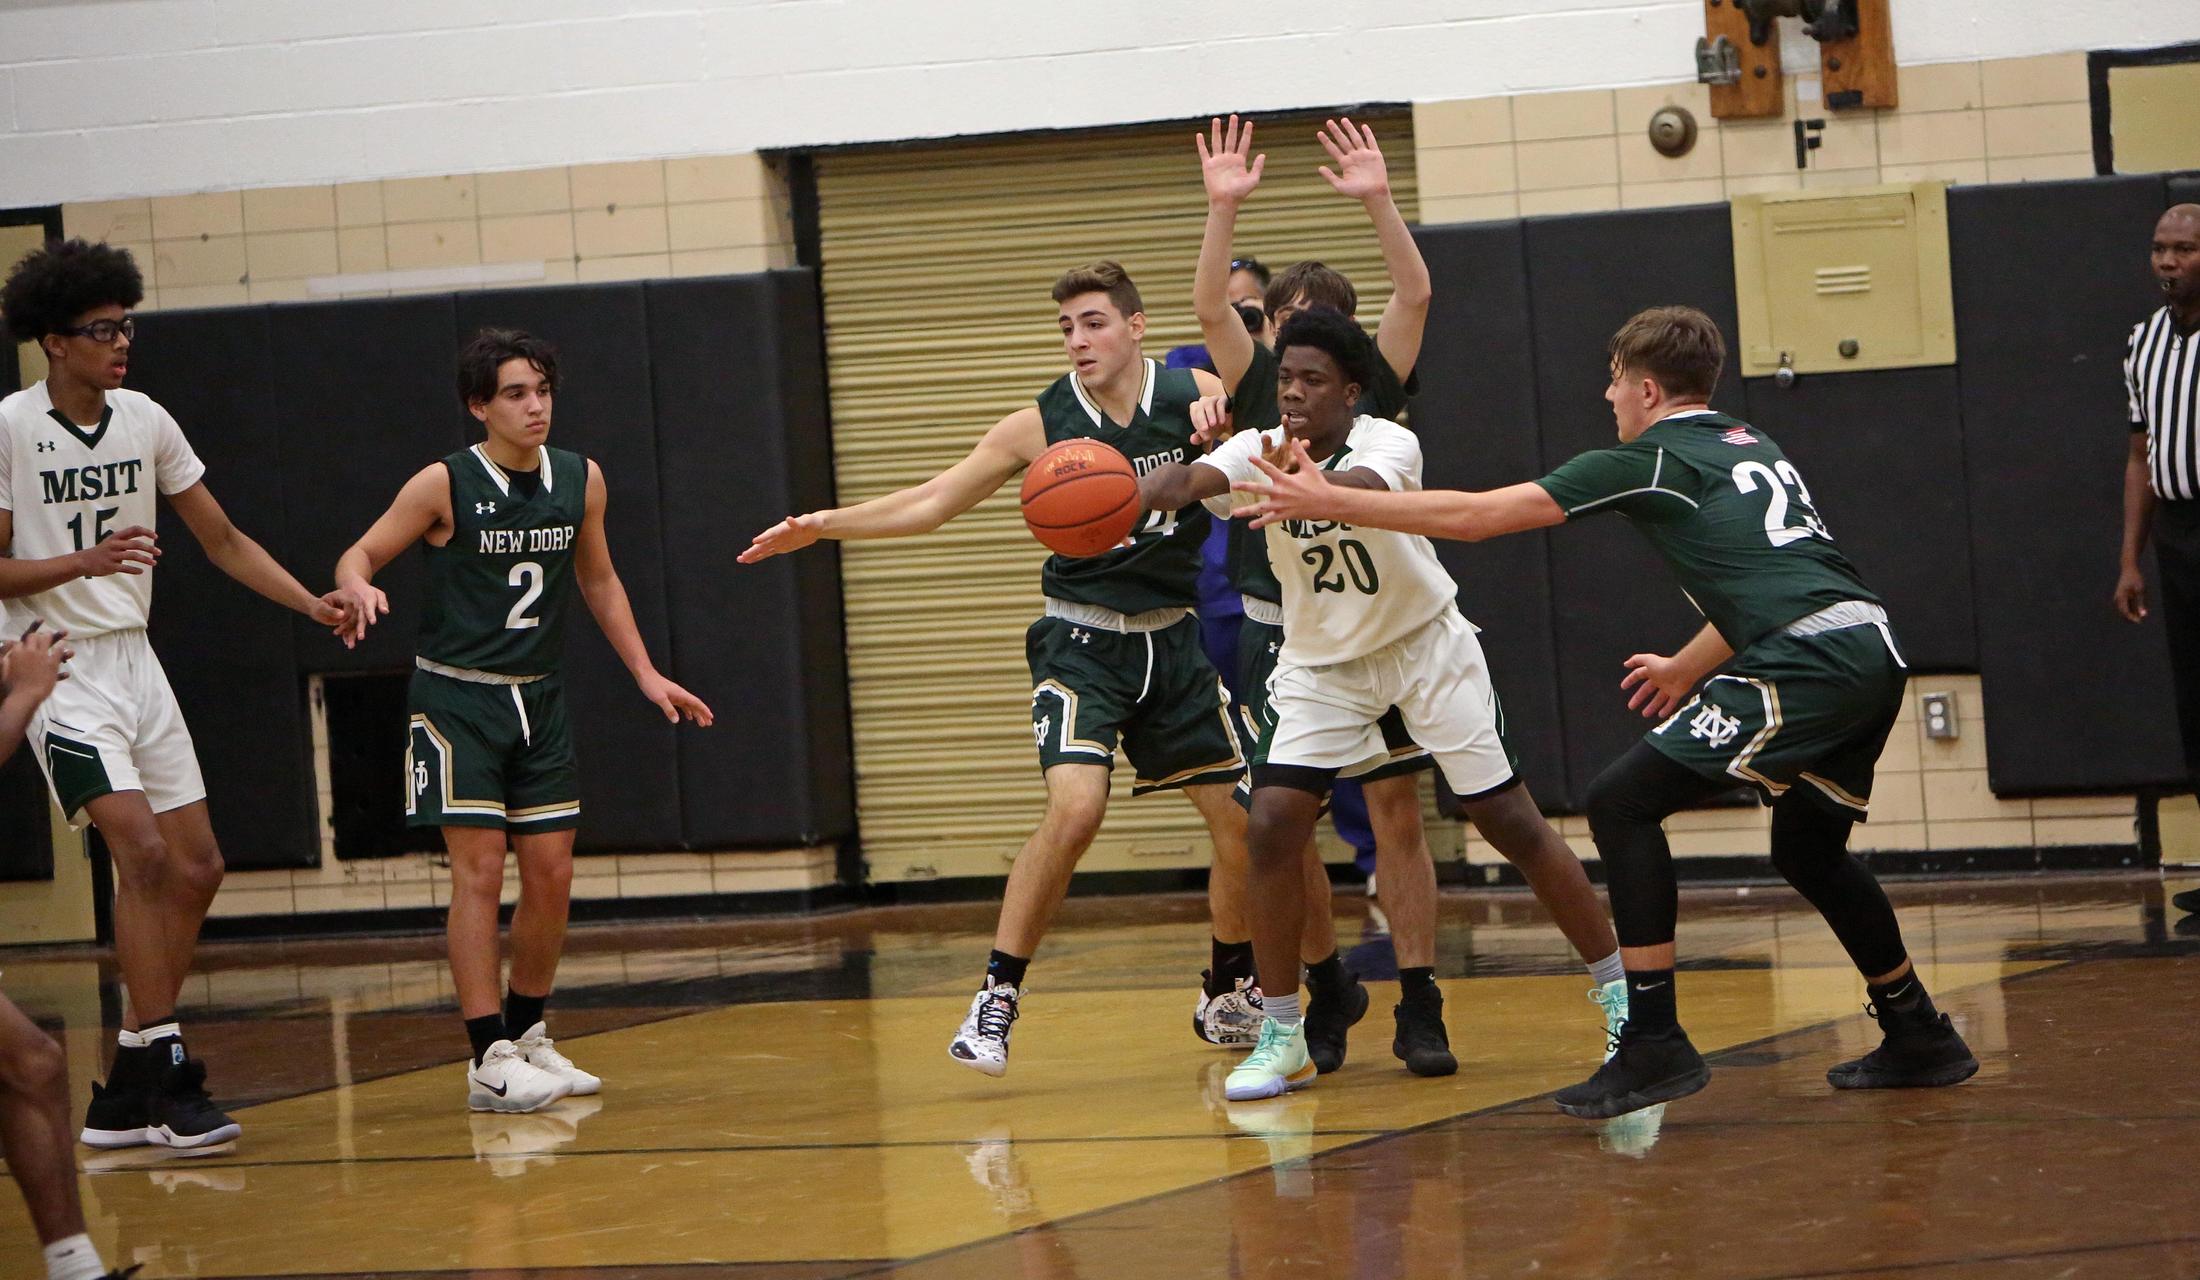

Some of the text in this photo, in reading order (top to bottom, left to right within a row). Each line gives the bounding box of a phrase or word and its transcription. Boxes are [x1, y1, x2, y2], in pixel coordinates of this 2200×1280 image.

[39, 459, 142, 504] MSIT
[1054, 461, 1087, 478] ROCK
[479, 525, 574, 554] NEW DORP
[1301, 539, 1379, 595] 20
[505, 562, 544, 629] 2
